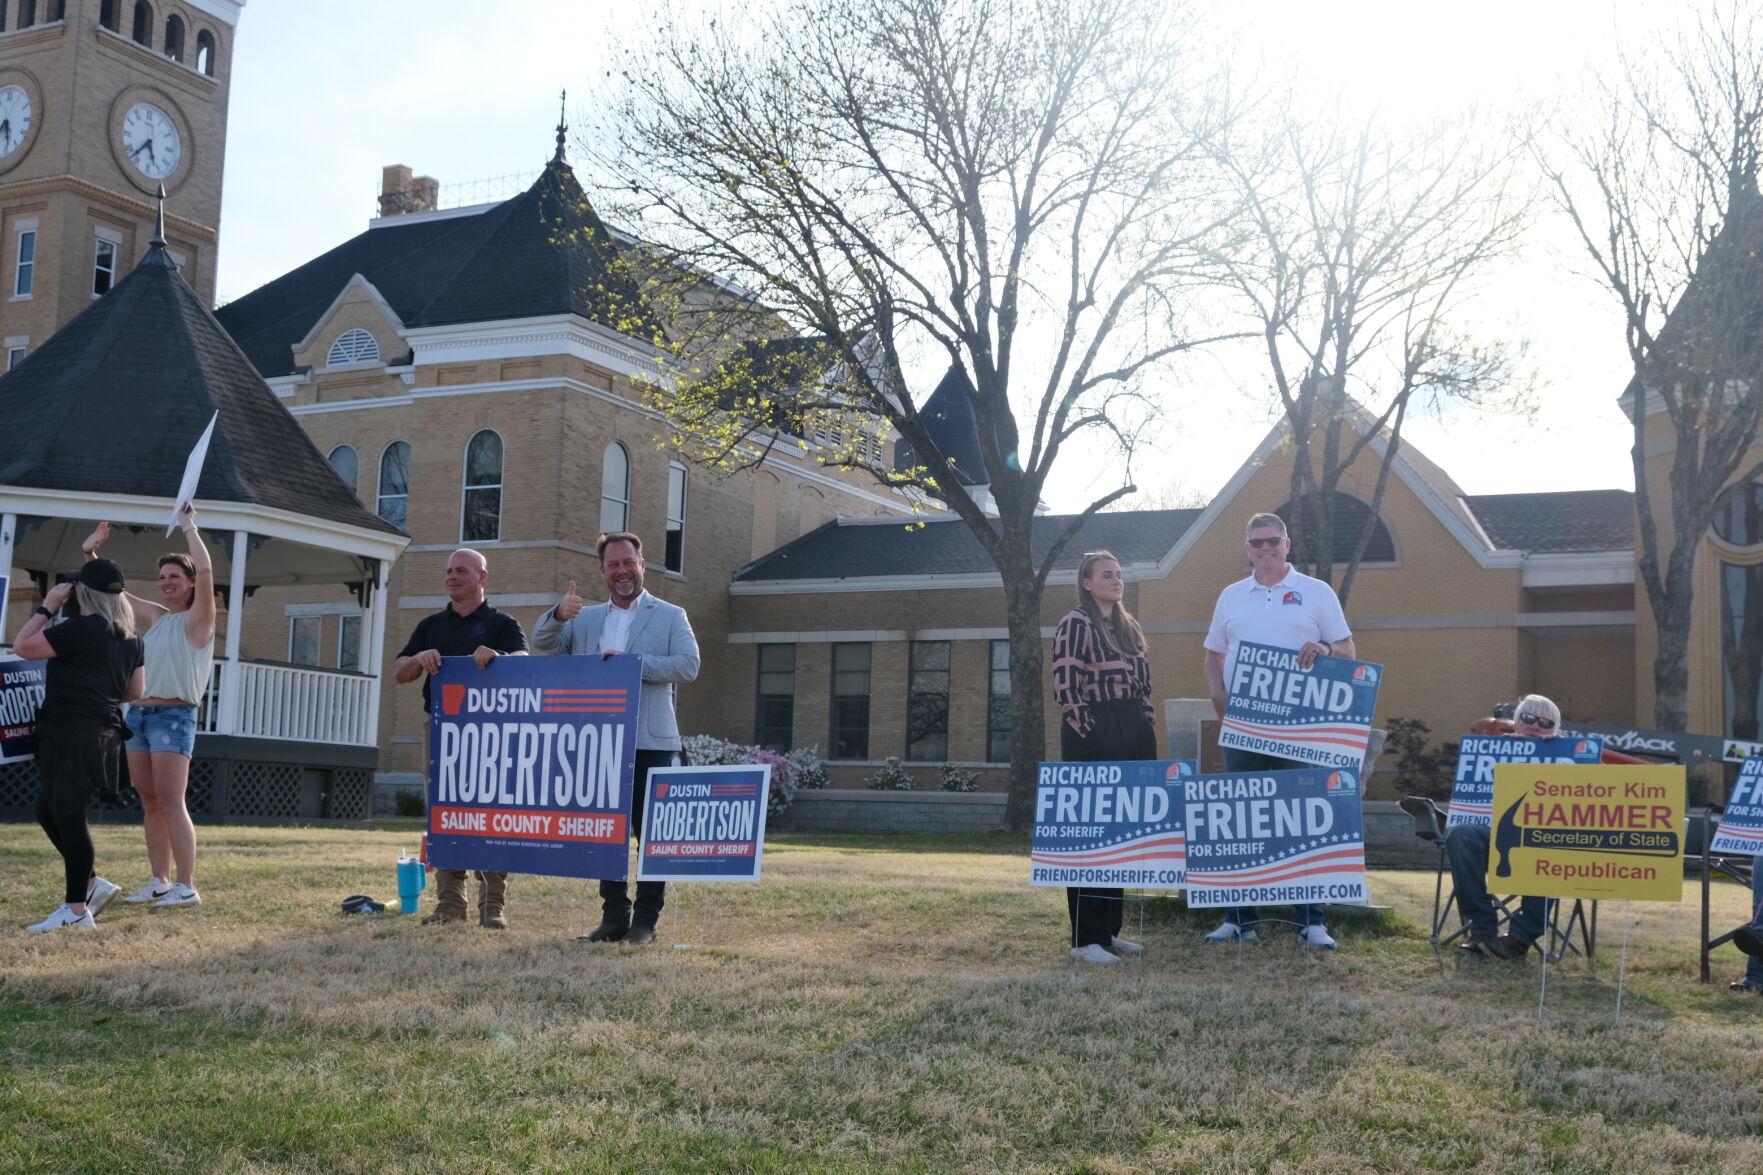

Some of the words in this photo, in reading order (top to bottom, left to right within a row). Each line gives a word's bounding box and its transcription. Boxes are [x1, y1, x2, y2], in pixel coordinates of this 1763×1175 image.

[3, 669, 42, 685] DUSTIN
[1231, 663, 1354, 713] FRIEND
[467, 687, 542, 713] DUSTIN
[1229, 696, 1250, 708] FOR
[1250, 699, 1293, 717] SHERIFF
[4, 727, 31, 738] SALINE
[1221, 731, 1361, 768] FRIENDFORSHERIFF.COM
[1461, 738, 1536, 755] RICHARD
[438, 722, 625, 809] ROBERTSON
[1039, 765, 1122, 785] RICHARD
[669, 784, 711, 798] DUSTIN
[1185, 777, 1277, 801] RICHARD
[1455, 783, 1475, 793] FOR
[1534, 780, 1616, 798] Senator
[1624, 782, 1666, 799] Kim
[1035, 786, 1170, 823] FRIEND
[1727, 805, 1747, 817] FOR
[440, 811, 487, 831] SALINE
[492, 813, 552, 835] COUNTY
[558, 816, 615, 838] SHERIFF
[650, 800, 756, 841] ROBERTSON
[1185, 797, 1334, 842] FRIEND
[1523, 802, 1674, 830] HAMMER
[1035, 825, 1059, 837] FOR
[1059, 825, 1105, 838] SHERIFF
[1531, 830, 1603, 848] Secretary
[1609, 832, 1625, 846] of
[1629, 833, 1670, 847] State
[650, 845, 678, 855] SALINE
[680, 845, 715, 855] COUNTY
[717, 844, 750, 855] SHERIFF
[1187, 844, 1213, 857] FOR
[1214, 841, 1265, 857] SHERIFF
[1033, 868, 1188, 884] FRIENDFORSHERIFF.COM
[1535, 859, 1657, 881] Republican
[1191, 883, 1363, 904] FRIENDFORSHERIFF.COM
